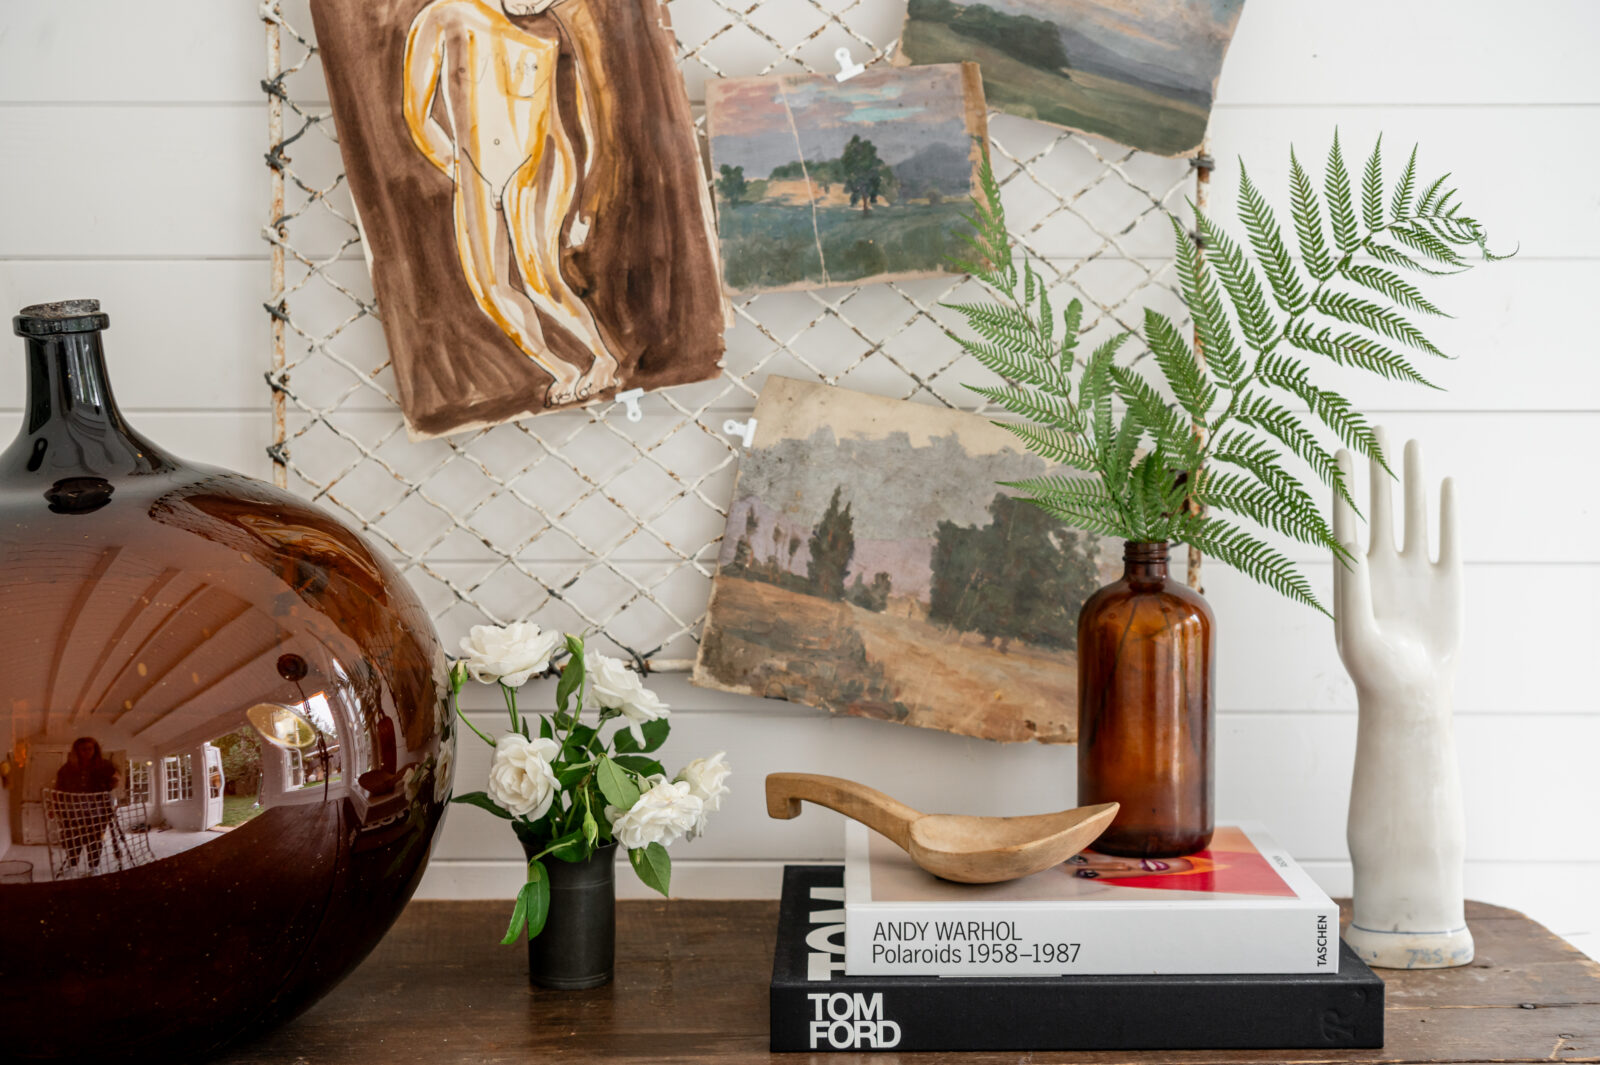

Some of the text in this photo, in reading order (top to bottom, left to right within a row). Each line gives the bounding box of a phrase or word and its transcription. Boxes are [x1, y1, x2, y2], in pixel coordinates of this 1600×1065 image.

[873, 921, 1022, 941] ANDY WARHOL
[1317, 915, 1327, 967] TASCHEN
[872, 943, 962, 964] Polaroids
[807, 992, 884, 1021] TOM
[809, 1020, 902, 1049] FORD
